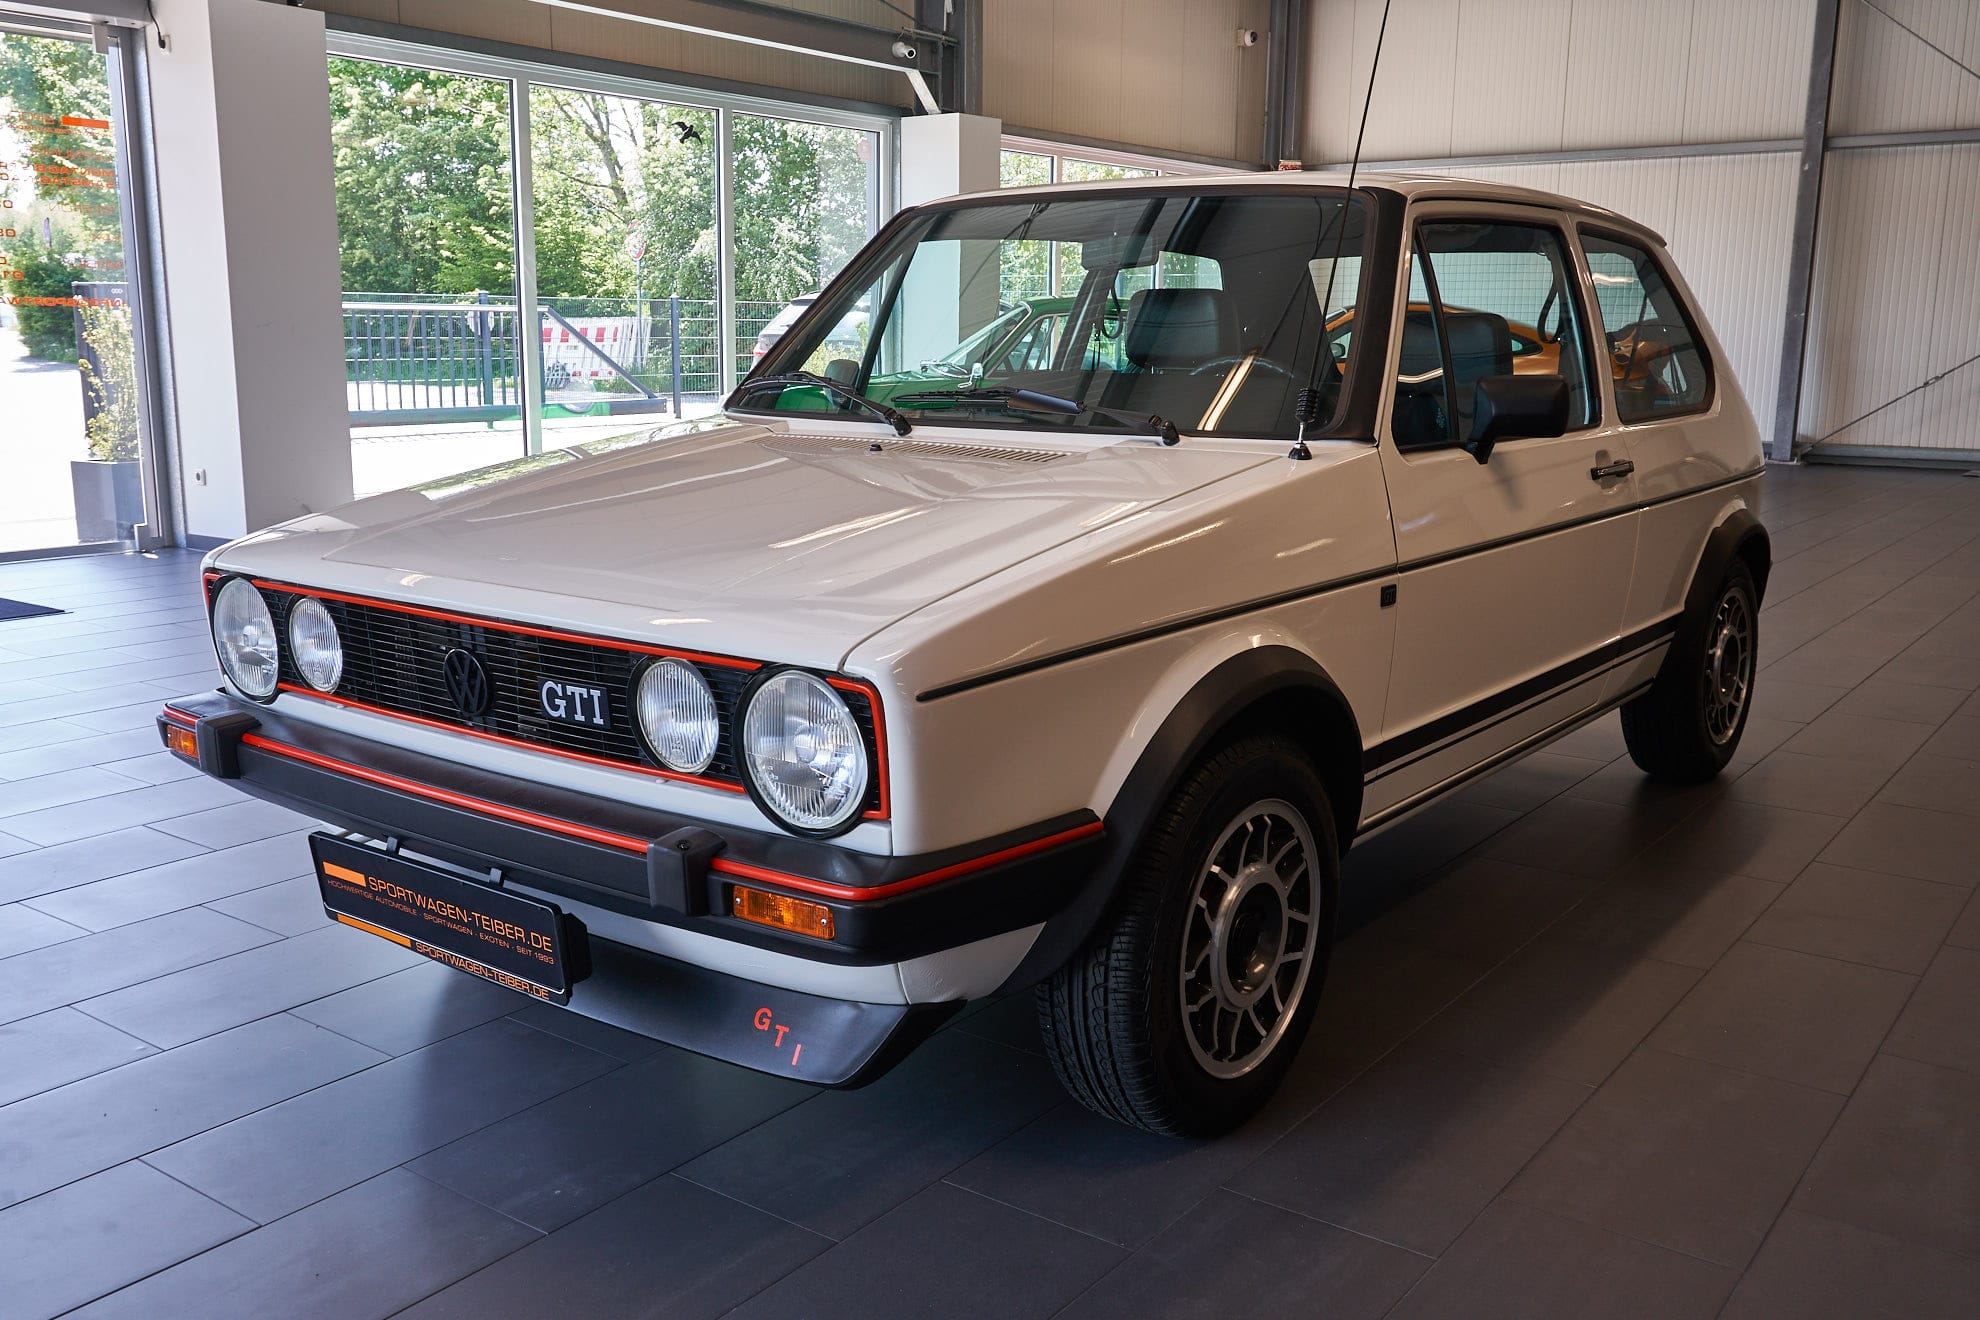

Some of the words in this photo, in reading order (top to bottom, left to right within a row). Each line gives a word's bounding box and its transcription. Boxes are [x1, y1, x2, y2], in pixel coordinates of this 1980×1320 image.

[541, 680, 604, 725] GTI
[327, 880, 374, 900] HOCHWERTIGE
[375, 895, 417, 915] AUTOMOBILE
[423, 912, 473, 936] SPORTWAGEN
[479, 932, 510, 949] EXOTEN
[516, 945, 532, 957] SEIT
[368, 876, 553, 953] SPORTWAGEN-TEIBER.DE
[415, 941, 550, 1000] SPORTWAGEN-TEIBER.DE
[754, 1007, 802, 1067] GTI
